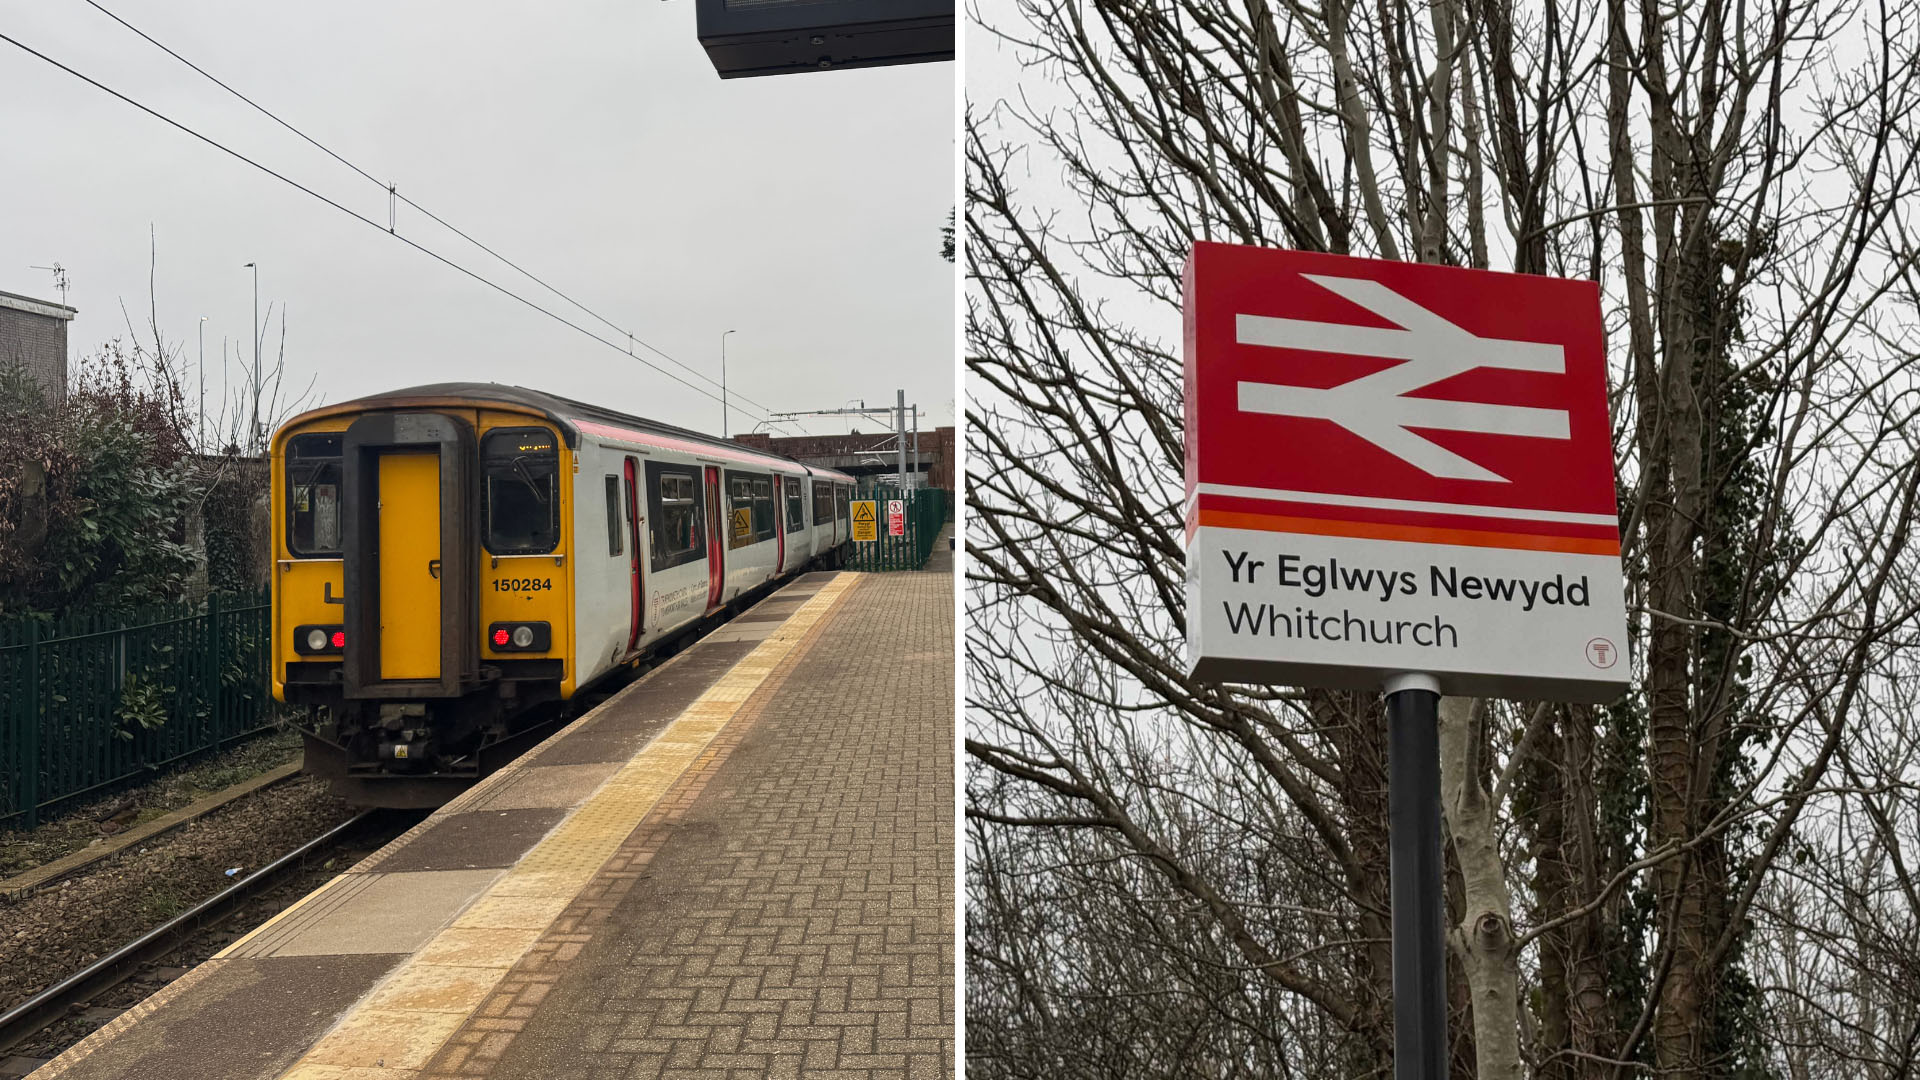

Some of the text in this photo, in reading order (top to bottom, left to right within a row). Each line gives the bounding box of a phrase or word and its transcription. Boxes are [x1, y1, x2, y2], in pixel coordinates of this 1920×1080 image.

[492, 578, 552, 592] 150284
[1222, 550, 1590, 612] Yr Eglwys Newydd
[1222, 598, 1458, 648] Whitchurch
[1593, 643, 1609, 664] T
